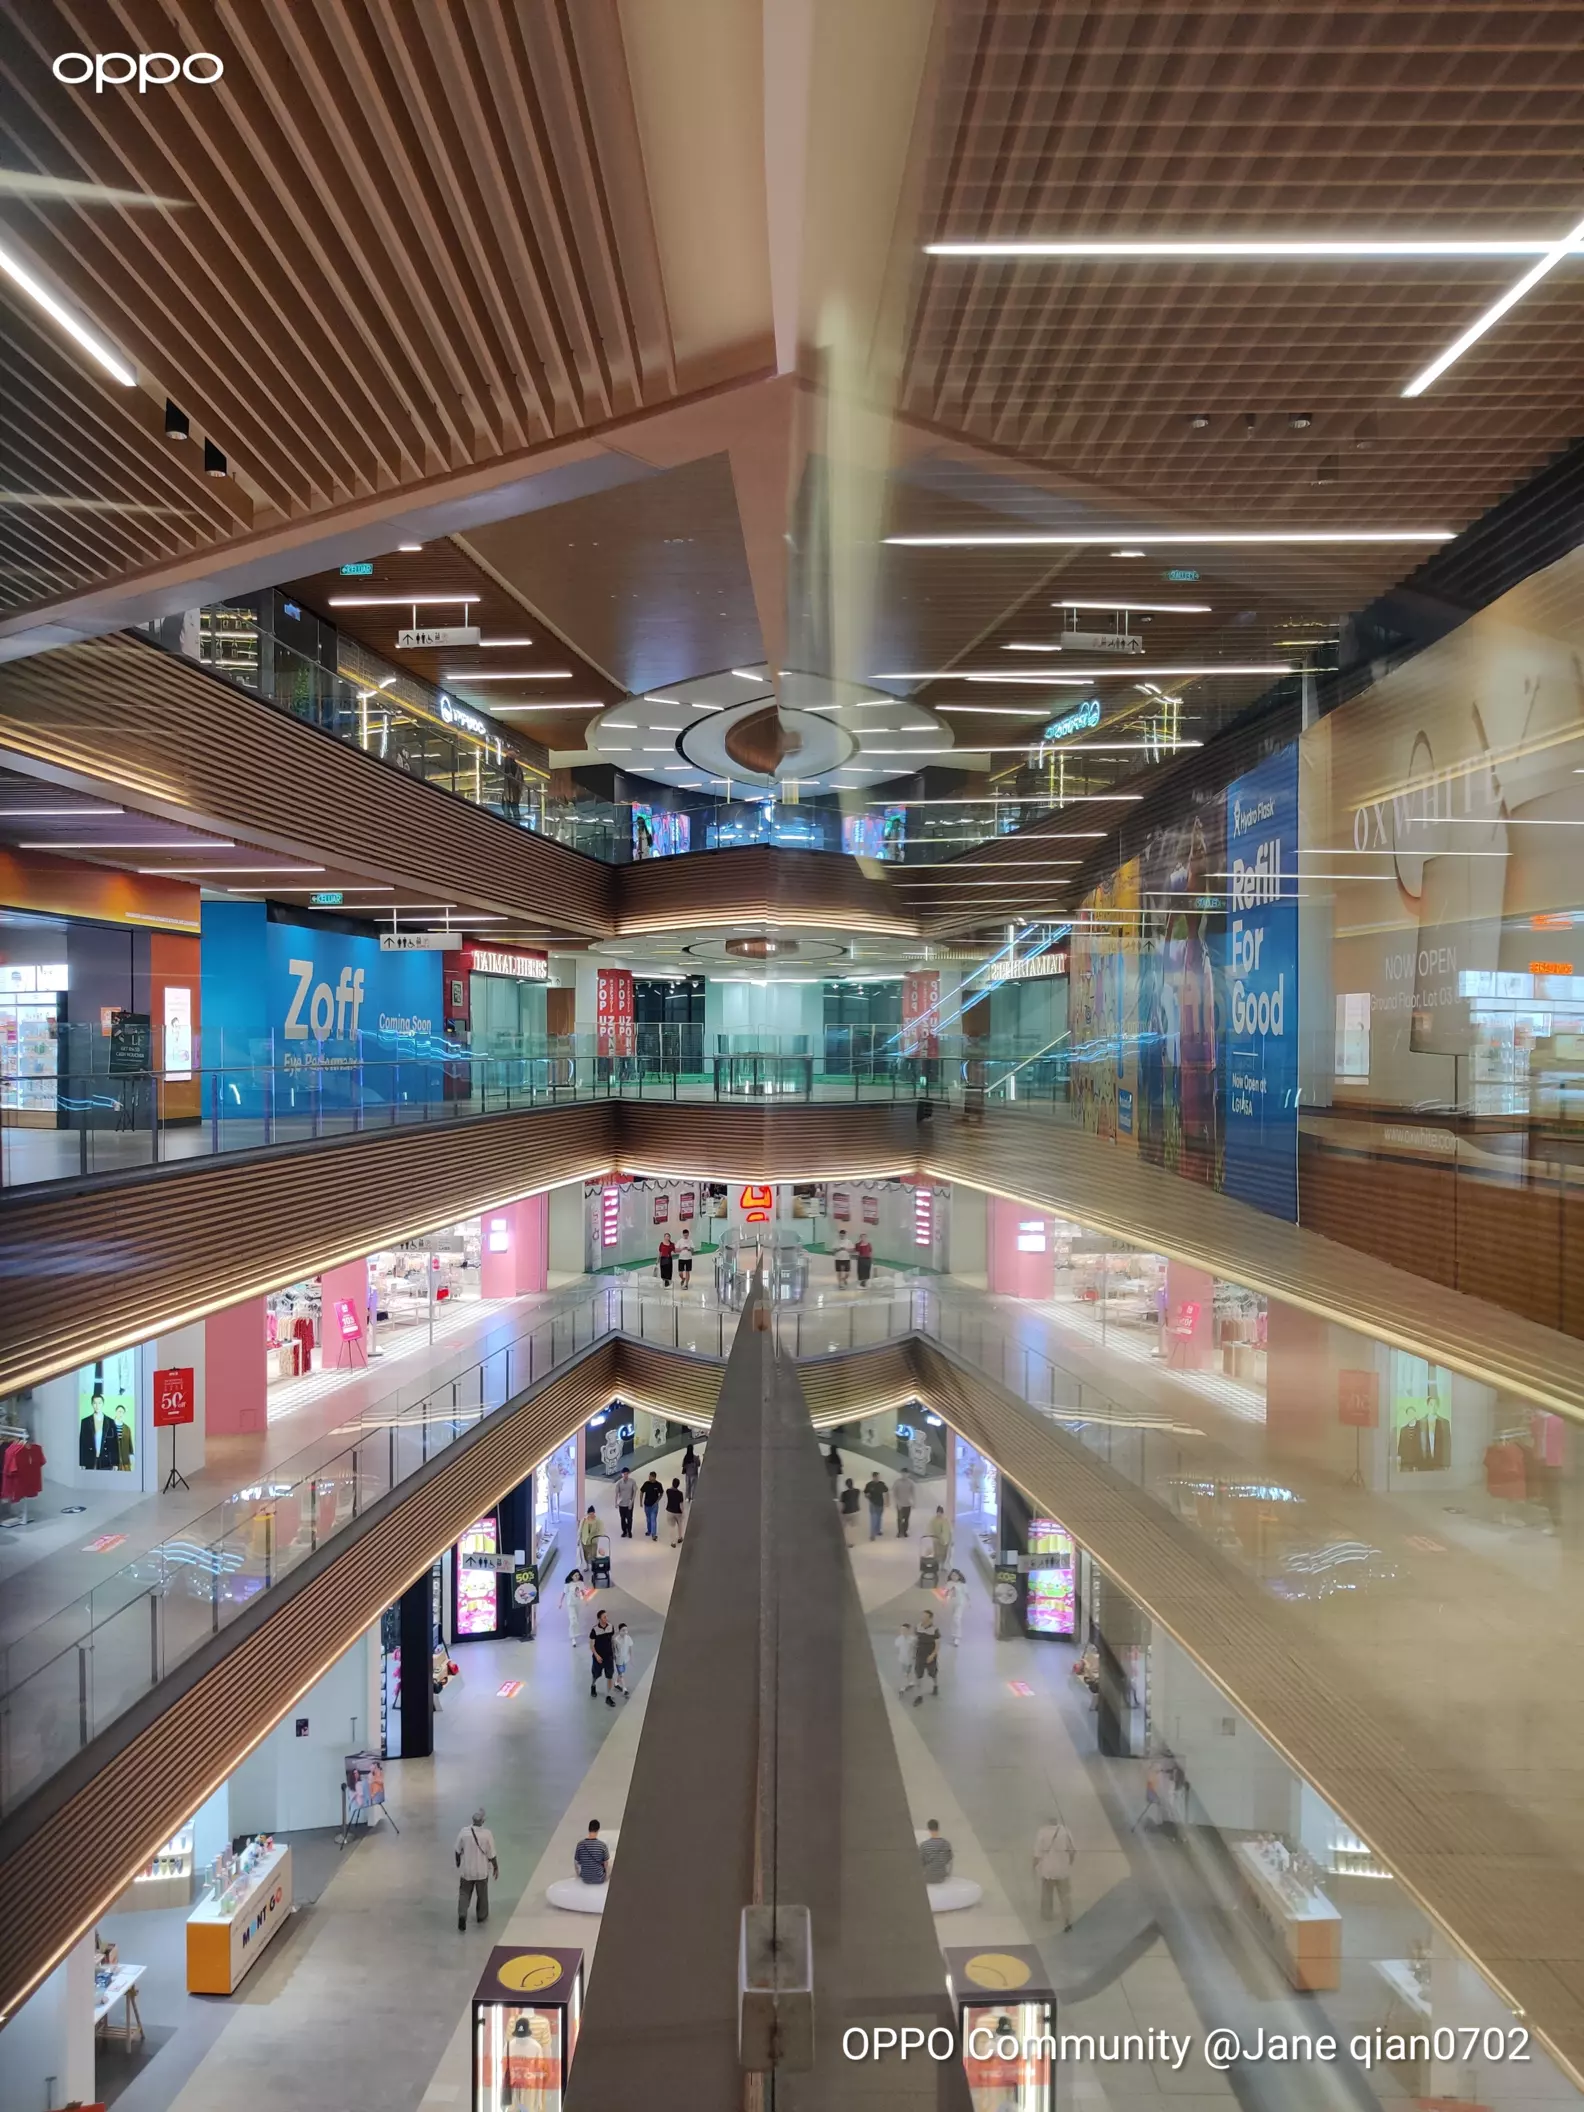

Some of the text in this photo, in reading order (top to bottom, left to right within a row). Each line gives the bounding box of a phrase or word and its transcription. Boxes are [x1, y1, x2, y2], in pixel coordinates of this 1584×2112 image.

[1240, 797, 1275, 834] Hydro Flask
[1232, 838, 1281, 913] Refill
[1232, 920, 1265, 977] For
[1385, 946, 1457, 981] NOW OPEN
[284, 958, 365, 1042] Zoff
[599, 978, 608, 1037] POP UP
[618, 978, 626, 1011] POP
[1231, 973, 1284, 1036] Good
[1422, 990, 1438, 1007] Lot
[1439, 987, 1453, 1006] 03
[378, 1012, 432, 1033] Coming Soon
[1231, 1072, 1244, 1089] Now
[1244, 1074, 1260, 1094] Open
